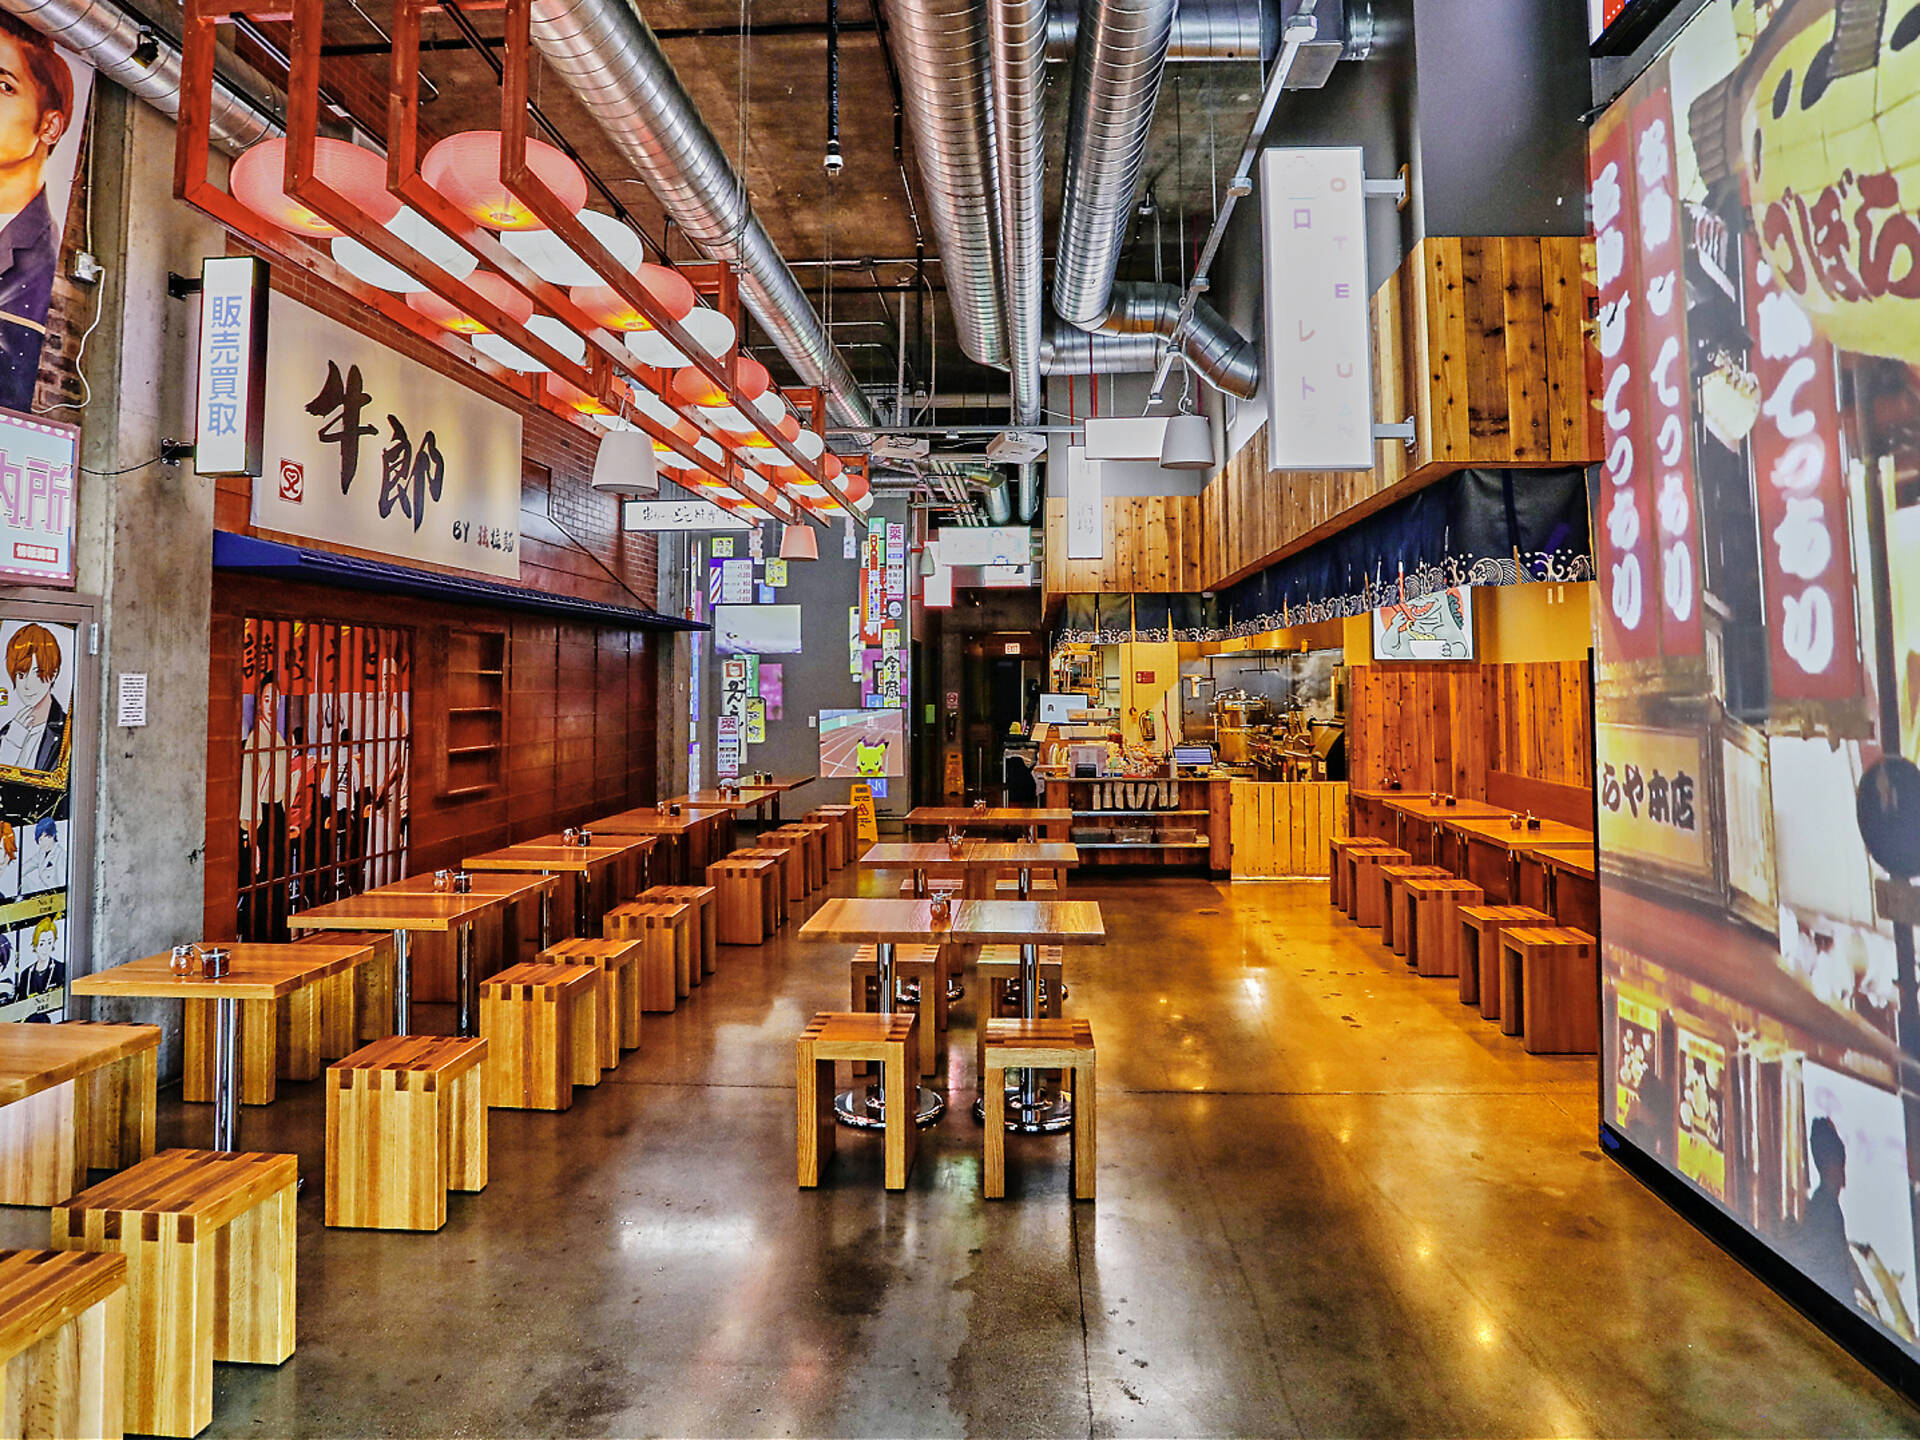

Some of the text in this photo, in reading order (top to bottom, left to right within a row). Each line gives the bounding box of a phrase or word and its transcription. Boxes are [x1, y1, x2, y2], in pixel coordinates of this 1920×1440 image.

[207, 296, 243, 437] 販売買取
[305, 360, 444, 532] 牛郎
[453, 520, 470, 543] BY
